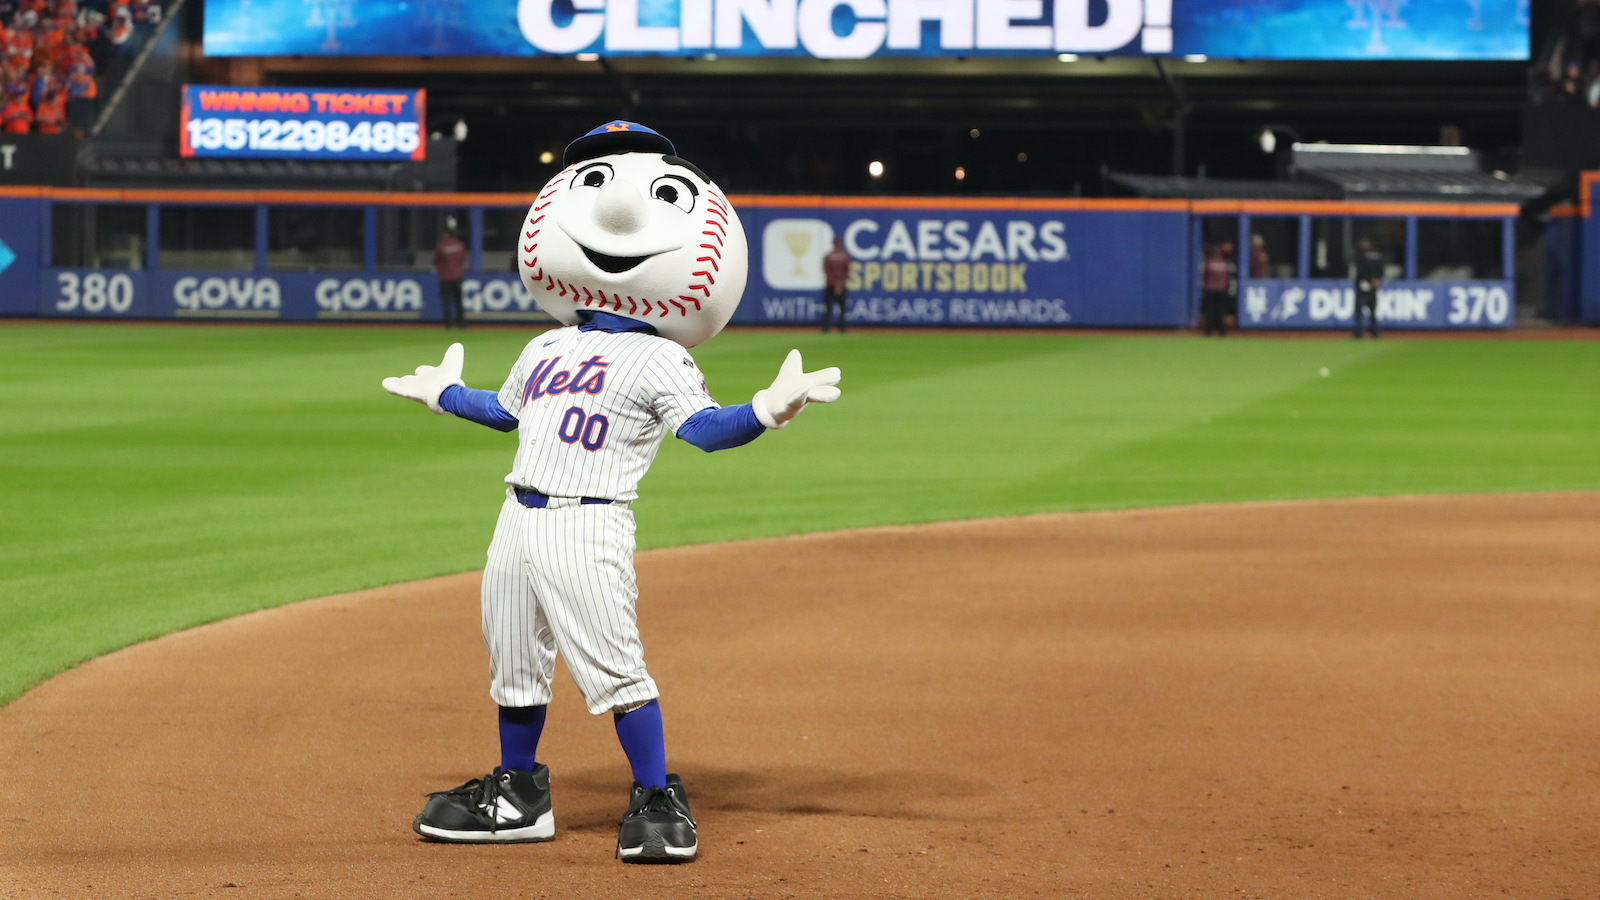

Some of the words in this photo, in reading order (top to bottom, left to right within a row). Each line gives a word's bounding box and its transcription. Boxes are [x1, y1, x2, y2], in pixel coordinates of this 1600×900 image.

[516, 0, 1173, 59] CLINCHED!
[200, 91, 310, 113] WINNING
[311, 93, 408, 114] TICKET
[187, 118, 420, 154] 13512298485
[844, 218, 1067, 262] CAESARS
[56, 272, 134, 313] 380
[173, 277, 282, 310] GOYA
[315, 279, 423, 311] GOYA
[846, 262, 1027, 293] SPORTSBOOK
[461, 279, 543, 313] GOY
[1308, 288, 1434, 321] DUKIN'
[1447, 287, 1509, 324] 370
[521, 355, 611, 408] Mets
[558, 405, 610, 452] 00
